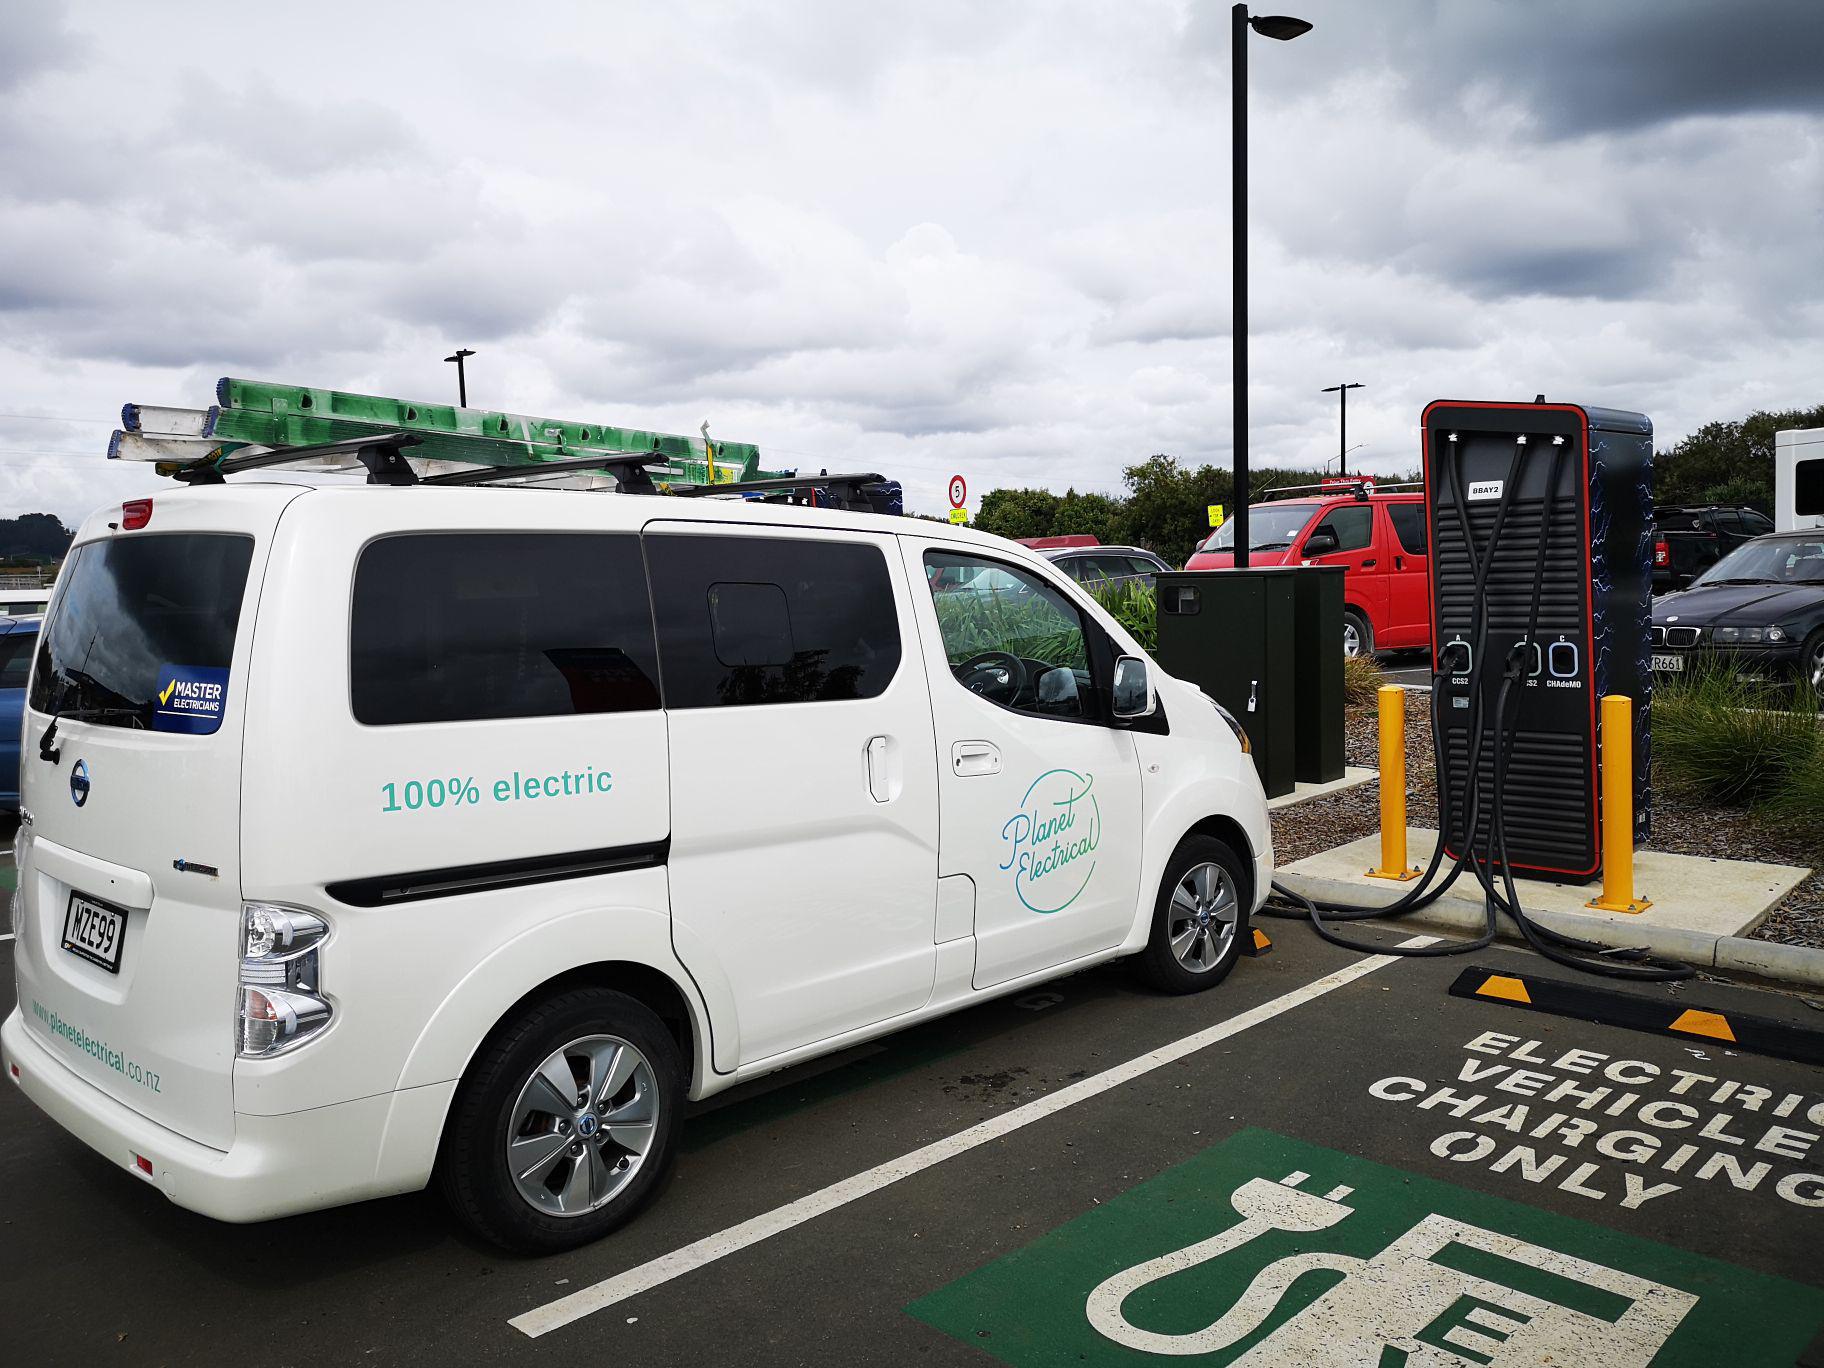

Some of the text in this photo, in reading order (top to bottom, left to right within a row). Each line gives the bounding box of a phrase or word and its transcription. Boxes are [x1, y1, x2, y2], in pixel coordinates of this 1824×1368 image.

[955, 485, 960, 498] 5
[1452, 677, 1469, 685] CCS2
[1546, 680, 1582, 688] CHAdeMO
[1651, 656, 1681, 669] R661
[173, 699, 220, 711] ELECTRICIANS
[175, 681, 222, 699] MASTER
[382, 766, 612, 812] 100% electric
[1000, 780, 1086, 870] Planet
[1018, 817, 1099, 882] Electrical
[72, 903, 116, 954] MZE99
[32, 999, 161, 1093] www.planetelectrical.co.nz
[1457, 1058, 1821, 1160] VEHICLE
[1368, 1076, 1824, 1208] CHARGING
[1429, 1131, 1682, 1209] ONLY
